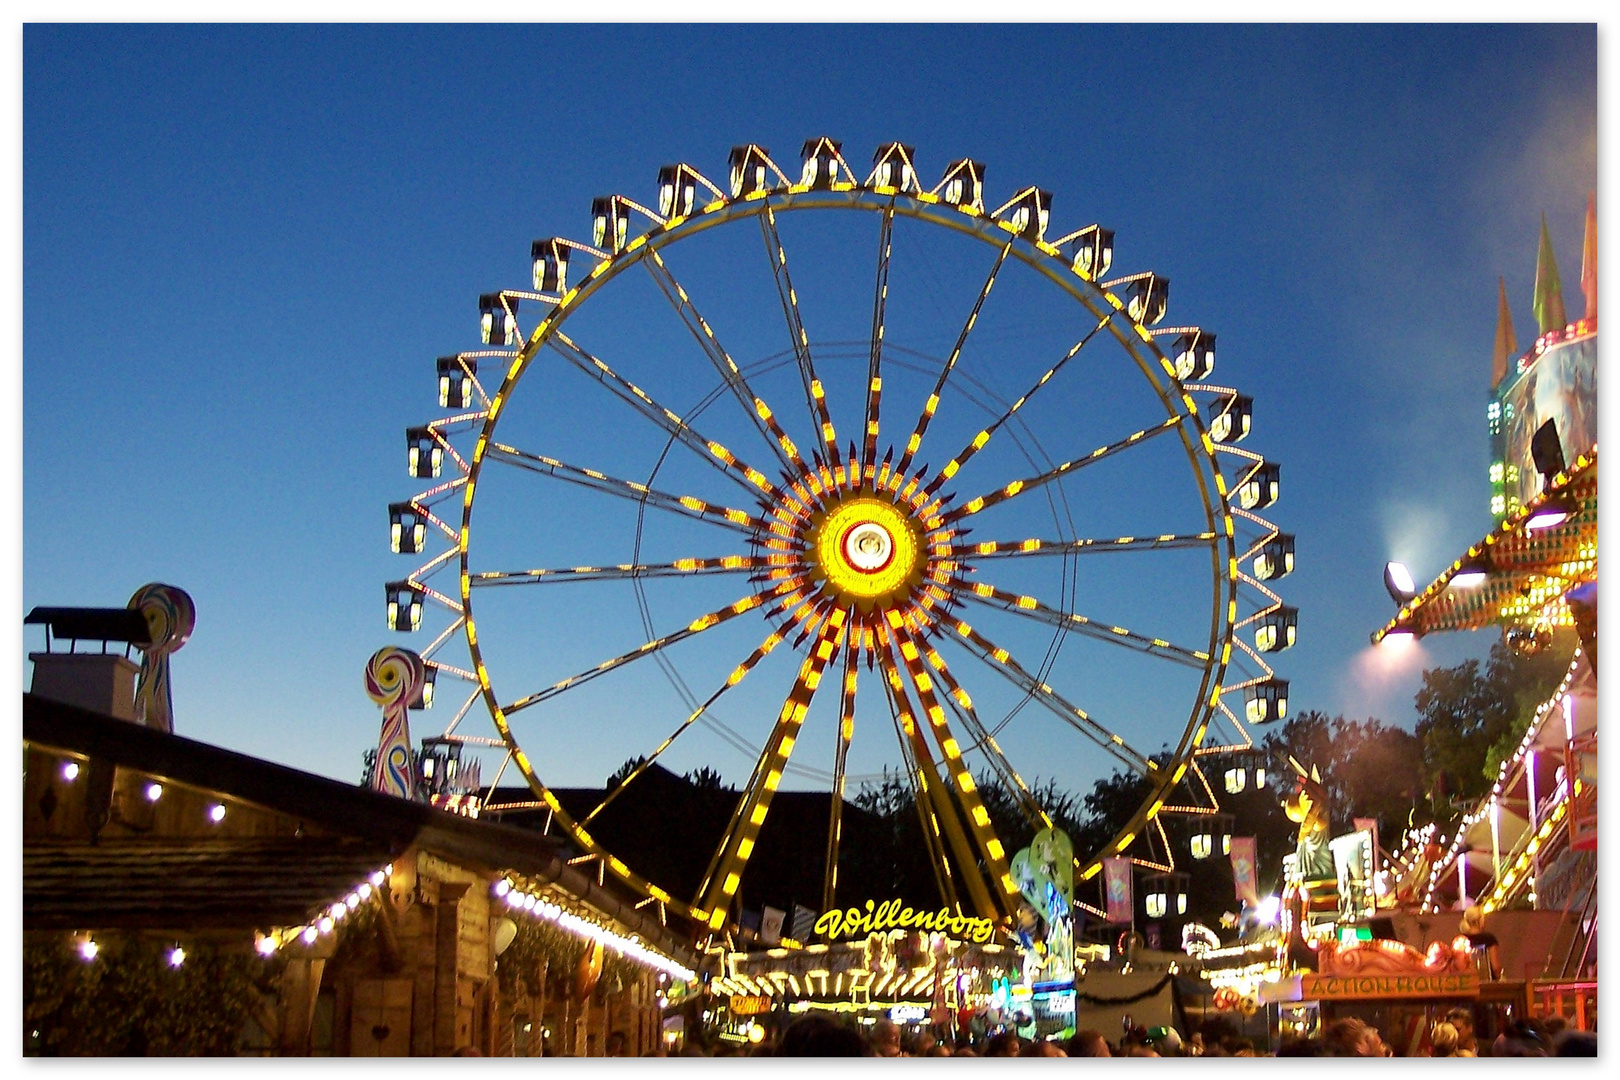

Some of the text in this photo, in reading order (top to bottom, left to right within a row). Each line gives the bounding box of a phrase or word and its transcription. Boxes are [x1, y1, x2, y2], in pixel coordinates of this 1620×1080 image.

[814, 898, 993, 942] Willenborg
[1311, 975, 1472, 995] ACTION HOUSE
